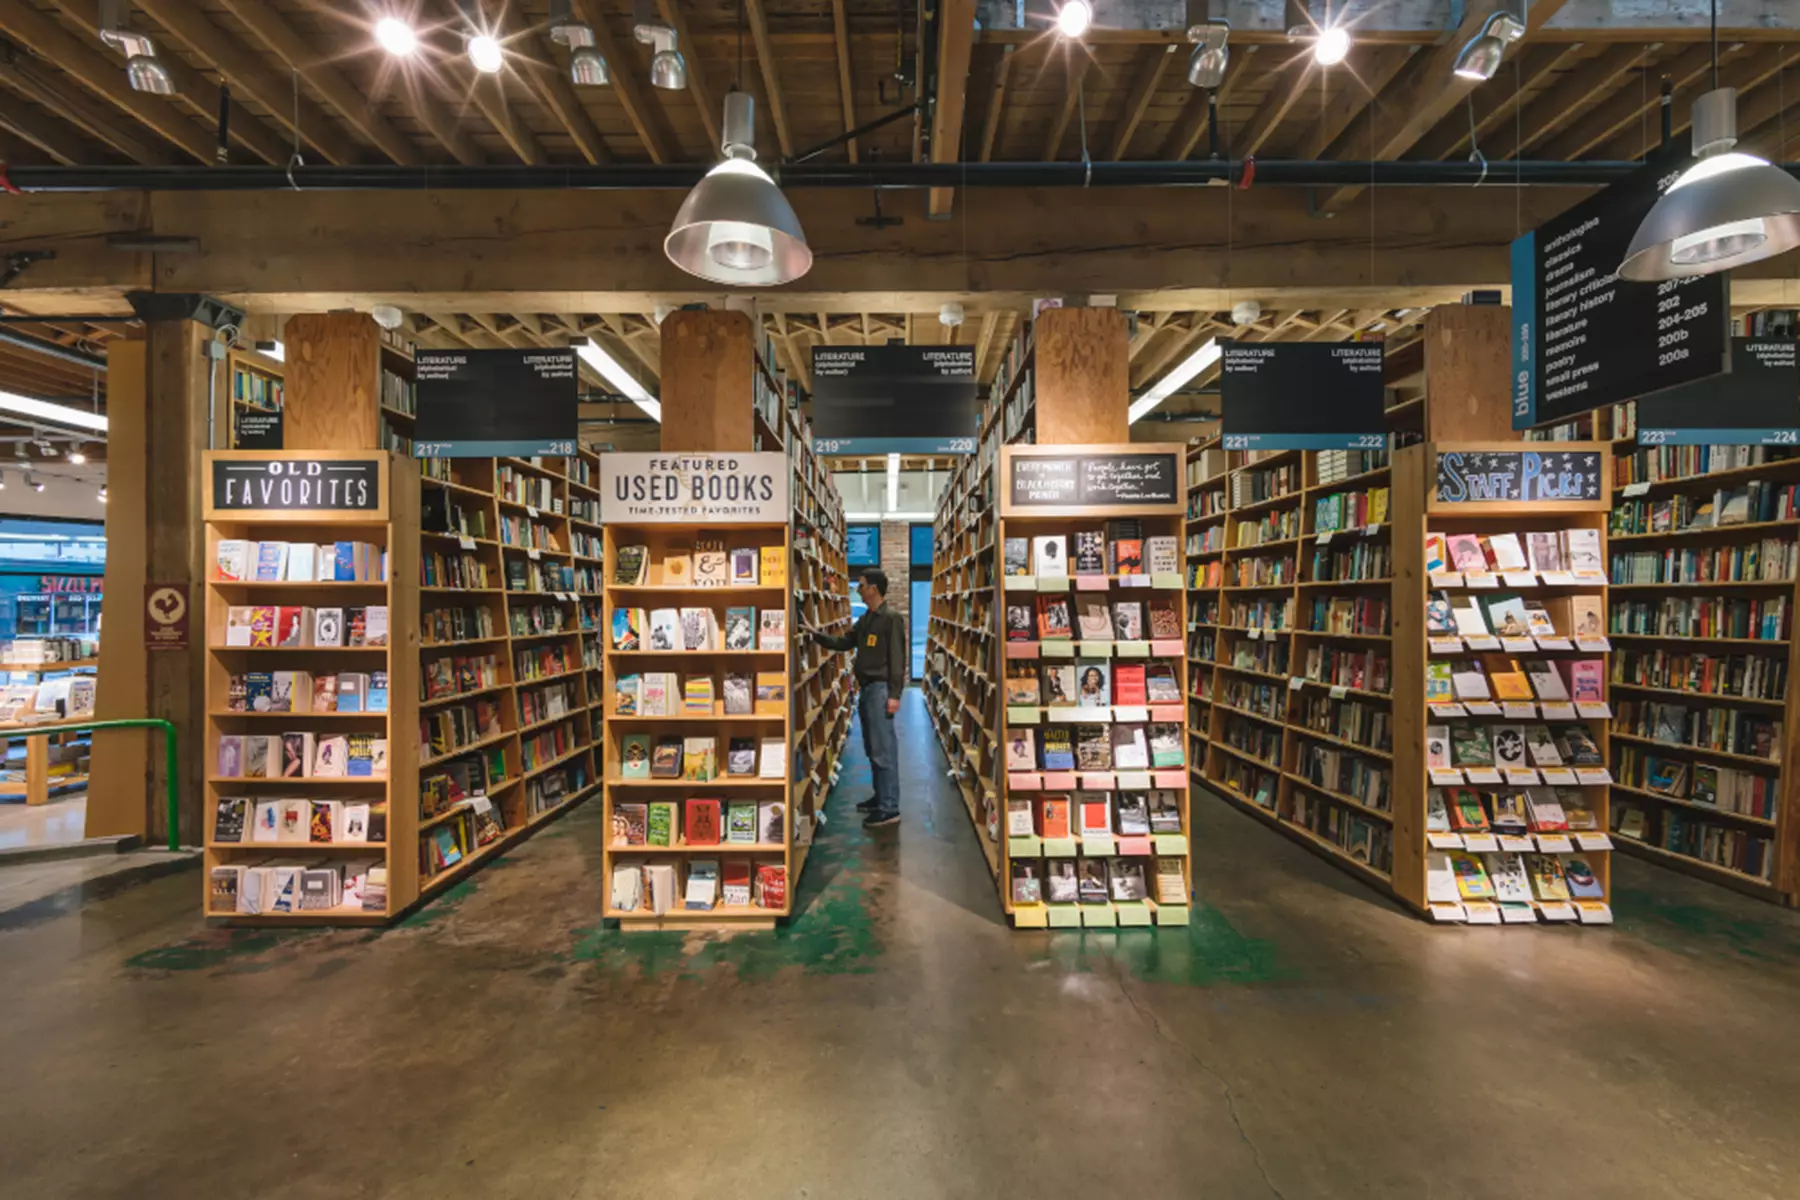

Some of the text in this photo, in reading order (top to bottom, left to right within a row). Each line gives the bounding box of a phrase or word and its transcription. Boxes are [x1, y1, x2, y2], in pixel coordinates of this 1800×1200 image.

[1544, 216, 1600, 253] anthologies
[1544, 242, 1583, 269] classics
[1545, 262, 1575, 282] drama
[1545, 267, 1596, 300] journalism
[1545, 291, 1578, 312] literary
[1545, 289, 1616, 327] literary history
[1657, 295, 1681, 313] 202
[1657, 301, 1708, 330] 204-205
[1545, 318, 1589, 342] literature
[1658, 328, 1690, 348] 200b
[1225, 349, 1275, 357] LITERATURE
[1331, 349, 1381, 357] LITERATURE
[1545, 333, 1588, 357] memoirs
[1745, 343, 1795, 352] LITERATURE
[417, 356, 467, 364] LITERATURE
[523, 356, 573, 364] LITERATURE
[815, 352, 865, 361] LITERATURE
[923, 352, 973, 360] LITERATURE
[1545, 353, 1576, 374] poetry
[1545, 361, 1600, 387] small press
[1515, 369, 1529, 416] blue
[1545, 381, 1589, 401] westerns
[816, 440, 839, 452] 219
[949, 440, 973, 451] 220
[1225, 436, 1383, 449] 221 222
[1642, 431, 1797, 444] 223 224
[417, 444, 441, 456] 217
[550, 442, 573, 454] 218
[268, 461, 322, 476] OLD
[649, 460, 739, 471] FEATURED
[1144, 461, 1160, 473] got
[226, 478, 368, 506] FAVORITES
[616, 475, 773, 501] USED BOOKS
[628, 506, 761, 515] TIME-TESTED FAVORITES
